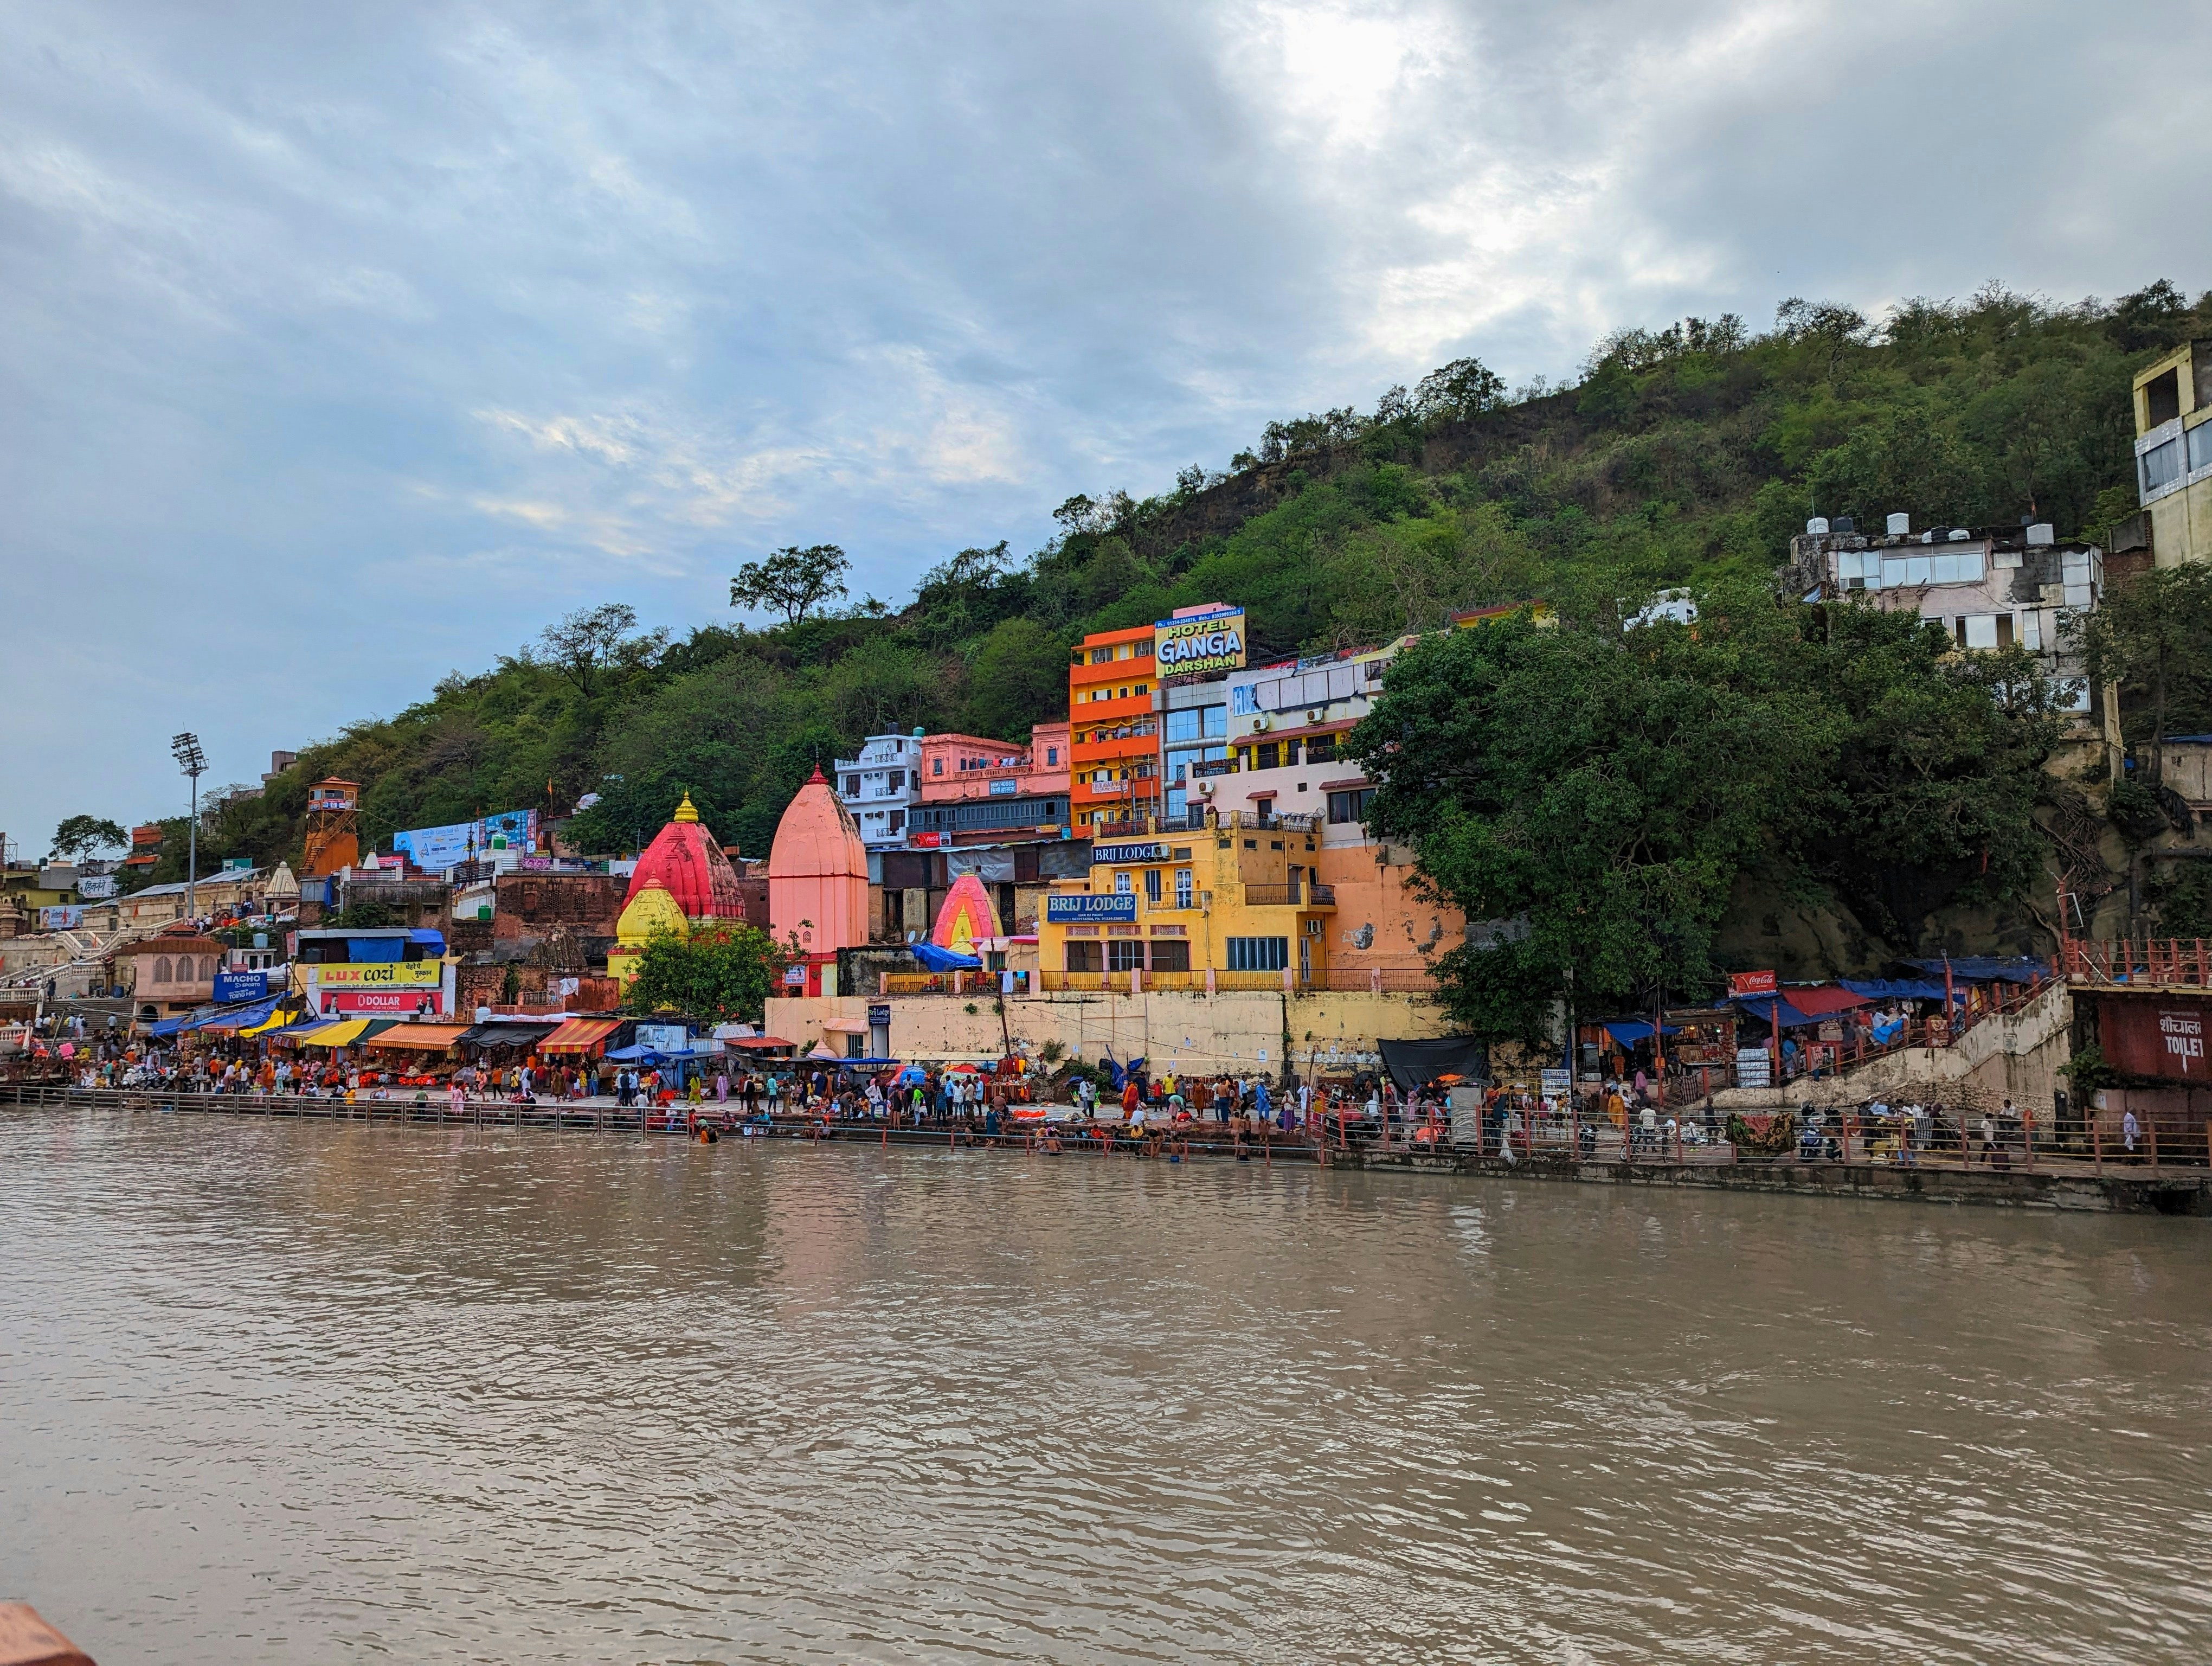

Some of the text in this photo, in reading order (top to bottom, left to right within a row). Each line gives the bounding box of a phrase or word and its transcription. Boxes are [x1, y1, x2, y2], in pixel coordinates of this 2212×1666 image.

[1168, 620, 1230, 638] HOTEL
[1158, 631, 1241, 663] GANGA
[1165, 655, 1236, 675] DARSHAN
[1095, 845, 1154, 861] BRIJ LODG
[1049, 896, 1133, 912] BRIJ LODGE
[325, 964, 395, 981] LUX cozi
[366, 996, 400, 1005] DOLLAR
[877, 1009, 889, 1017] Lodge
